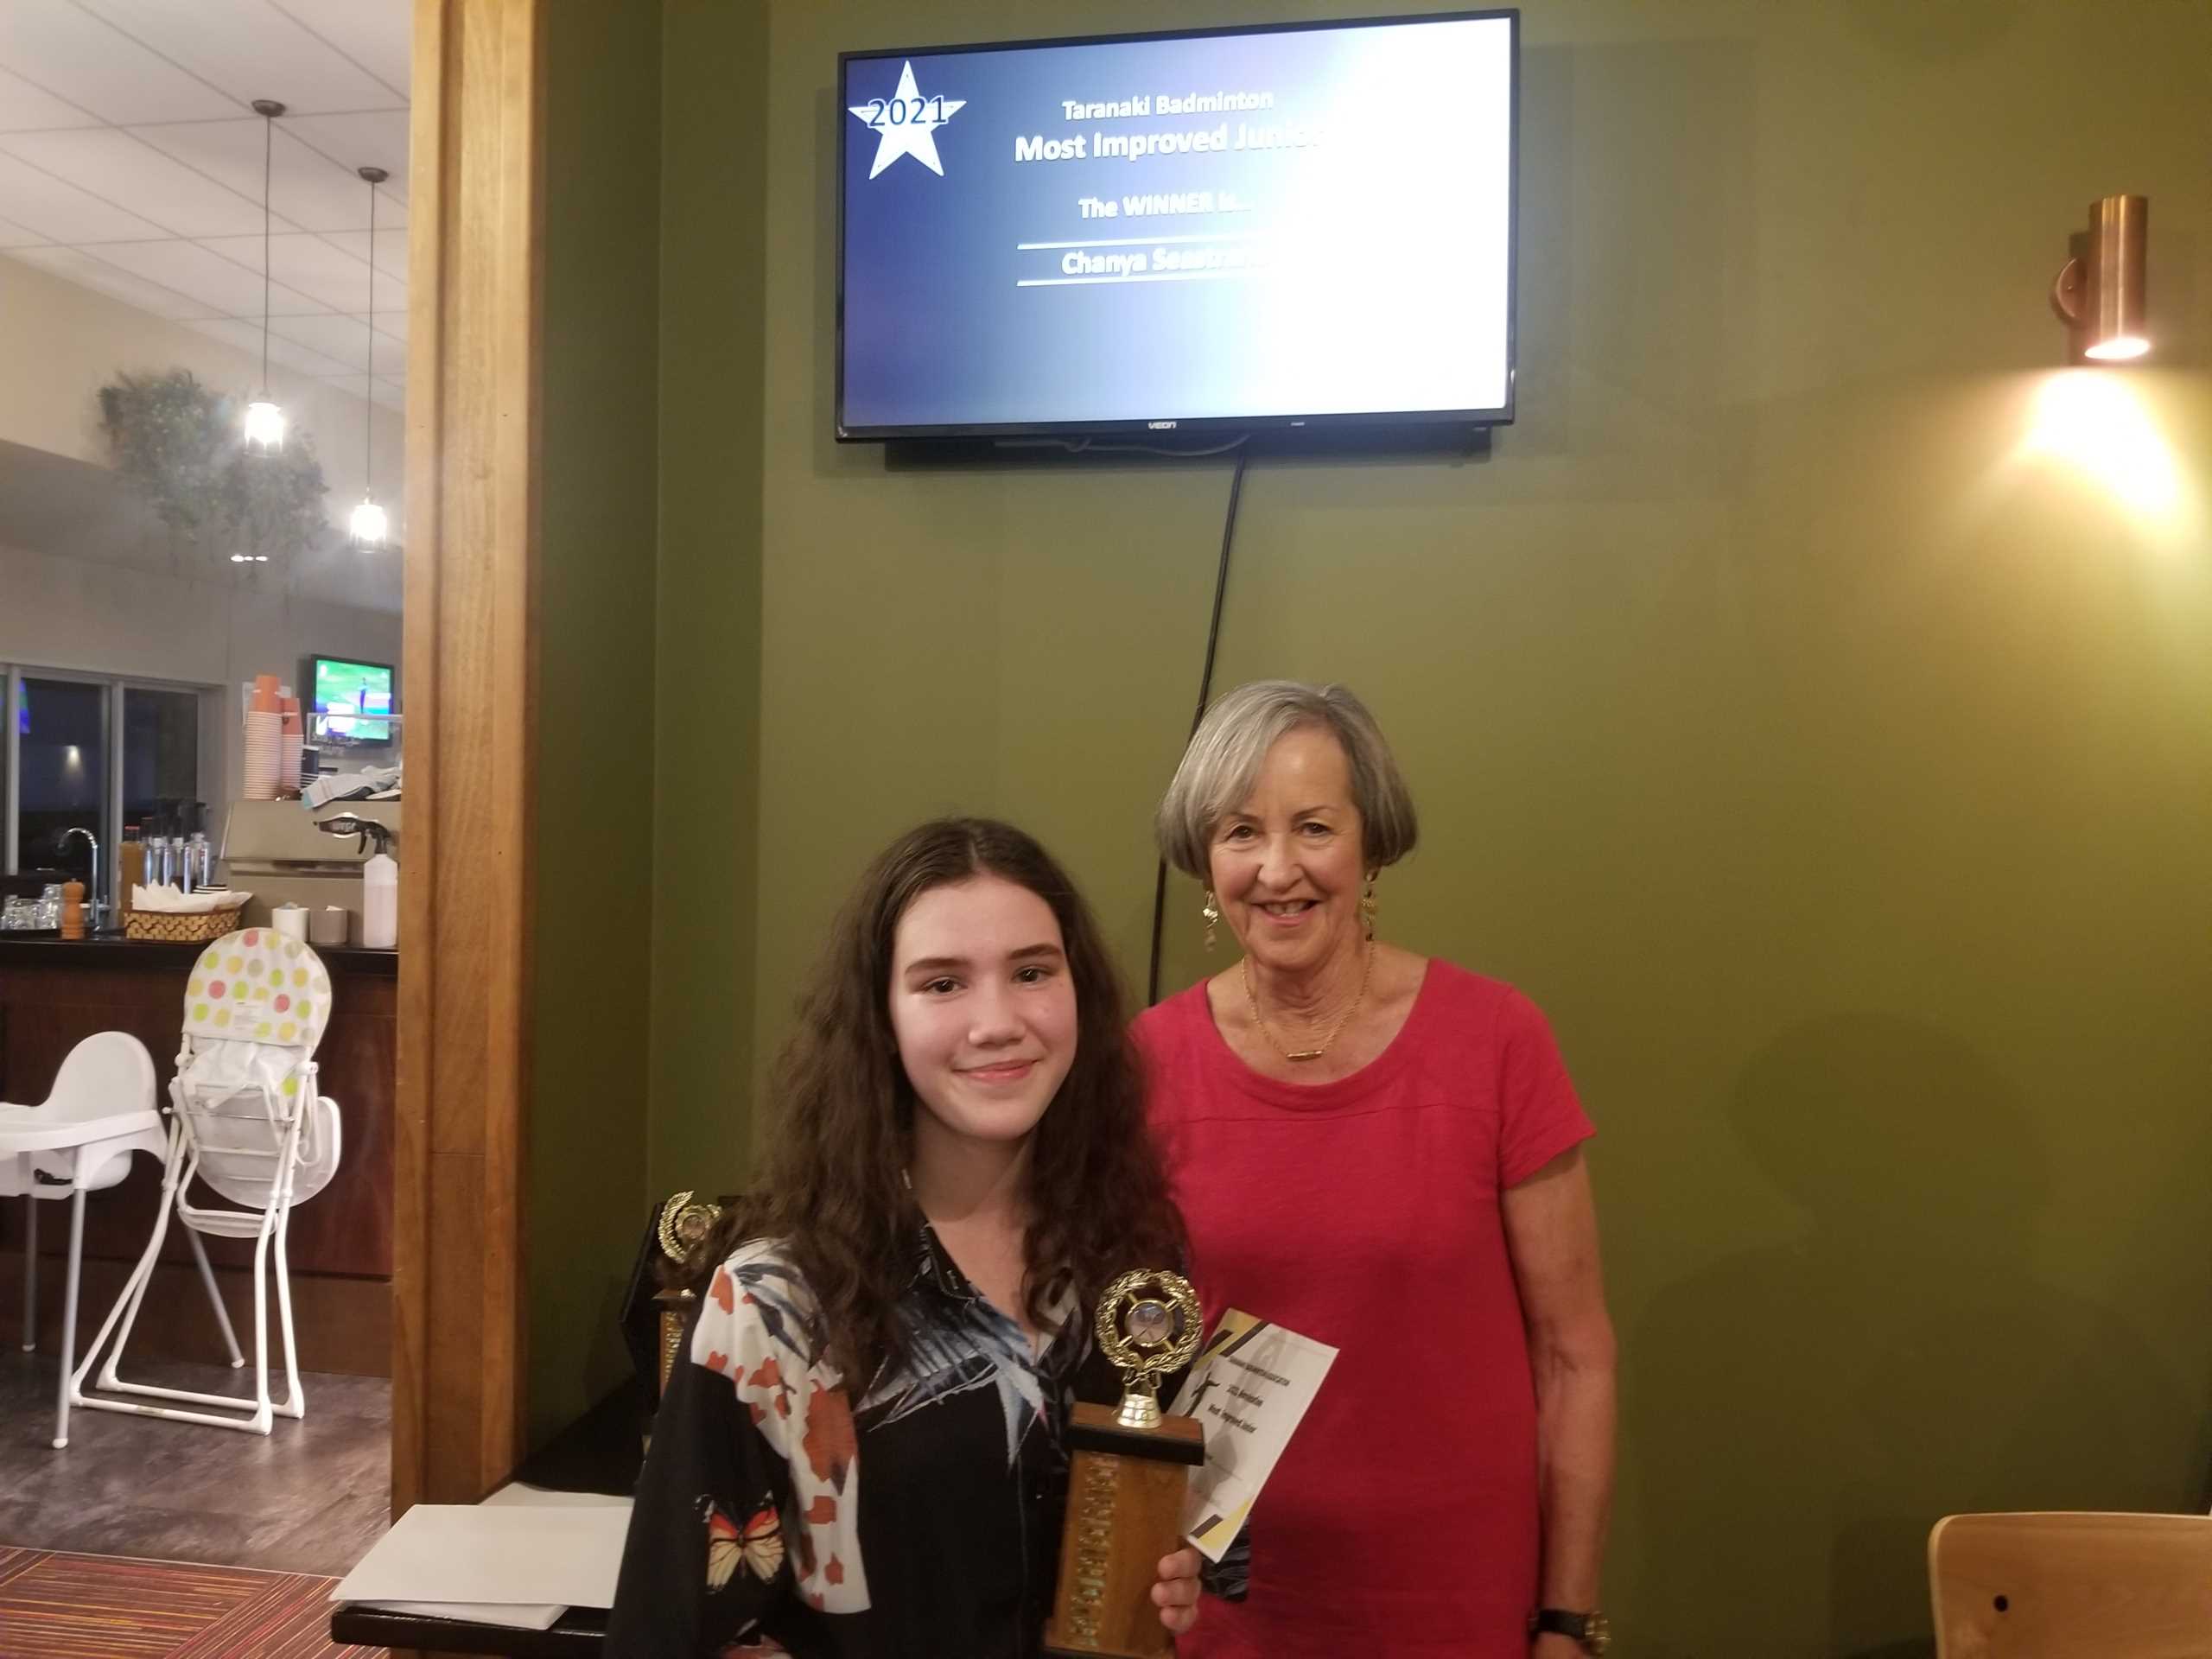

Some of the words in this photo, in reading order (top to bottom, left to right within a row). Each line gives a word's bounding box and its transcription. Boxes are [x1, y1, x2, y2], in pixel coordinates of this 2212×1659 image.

[868, 96, 948, 127] 2021
[1062, 96, 1150, 120] Taranaki
[1156, 83, 1274, 114] Badminton
[1015, 135, 1087, 162] Most
[1093, 122, 1228, 162] Improved
[1078, 197, 1118, 219] The
[1122, 193, 1213, 216] WINNER
[1061, 251, 1147, 276] Chanya
